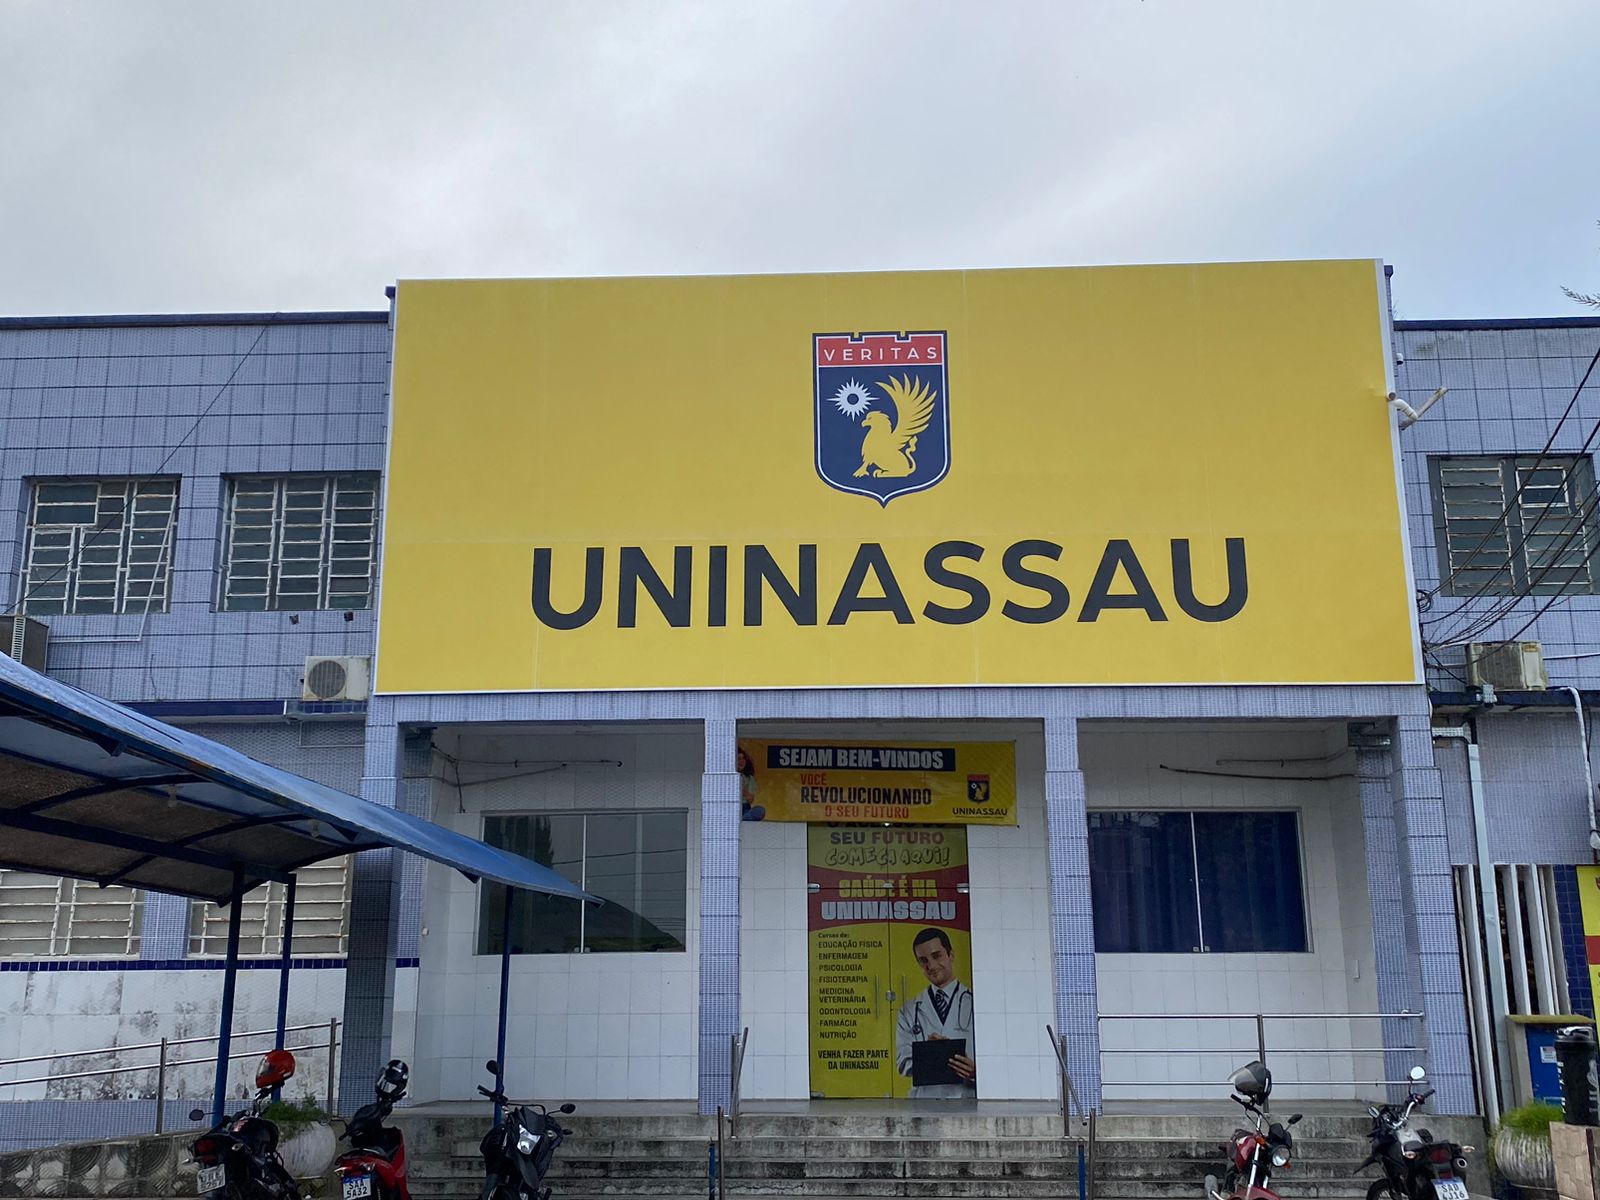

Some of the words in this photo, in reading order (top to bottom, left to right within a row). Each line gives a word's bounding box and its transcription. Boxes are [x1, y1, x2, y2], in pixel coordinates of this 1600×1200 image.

[823, 346, 938, 362] VERITAS
[531, 537, 1249, 630] UNINASSAU
[779, 748, 833, 768] SEJAM
[837, 749, 944, 769] BEM-VINDOS
[801, 786, 932, 805] REVOLUCIONANDO
[825, 806, 832, 818] O
[836, 806, 859, 818] SEU
[863, 806, 910, 819] FUTURO
[952, 807, 1008, 816] UNINASSAU
[830, 831, 865, 845] SEU
[872, 831, 945, 845] FUTURO
[911, 879, 938, 897] NA
[821, 901, 956, 920] UNINASSAU
[818, 939, 858, 950] EDUCAÇÃO
[818, 952, 869, 960] ENFERMAGEM
[818, 964, 863, 972] PSICOLOGIA
[818, 975, 869, 984] FISIOTERAPIA
[819, 987, 855, 995] MEDICINA
[819, 995, 867, 1004] VETERINÁRIA
[819, 1007, 871, 1015] ODONTOLOGIA
[819, 1018, 857, 1027] FARMÁCIA
[819, 1030, 857, 1040] NUTRIÇÃO
[817, 1049, 841, 1059] VENHA
[842, 1049, 865, 1058] FAZER
[866, 1049, 889, 1058] PARTE
[828, 1061, 838, 1070] DA
[839, 1061, 879, 1070] UNINASSAU
